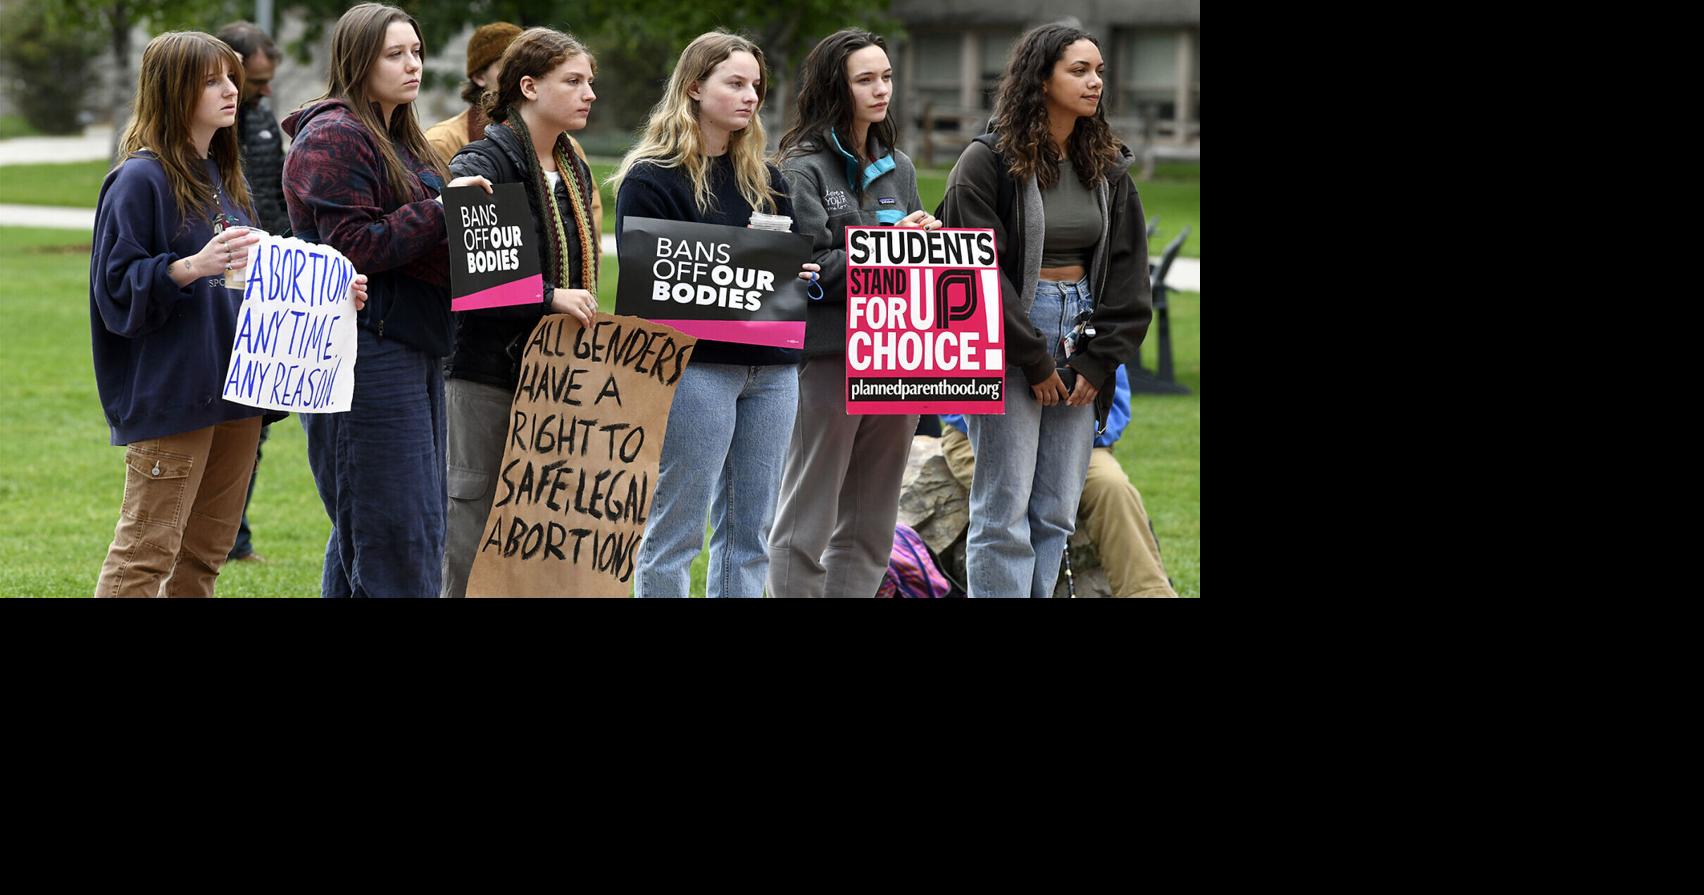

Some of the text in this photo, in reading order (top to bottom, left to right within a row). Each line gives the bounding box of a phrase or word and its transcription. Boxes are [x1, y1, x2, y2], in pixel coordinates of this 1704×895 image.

[461, 204, 498, 228] BANS
[464, 226, 523, 251] OFF OUR
[656, 237, 731, 264] BANS
[850, 230, 995, 266] STUDENTS
[467, 248, 519, 274] BODIES
[653, 259, 775, 292] OFF OUR
[652, 280, 762, 312] BODIES
[850, 268, 907, 295] STAND
[850, 297, 907, 330] FOR
[524, 318, 694, 386] ALL GENDERS
[224, 353, 271, 405] ANY
[514, 364, 622, 408] HAVE A
[851, 379, 1000, 400] plannedparenthood.org
[511, 410, 645, 463] RIGHT TO
[482, 514, 643, 583] ABORTIONS
